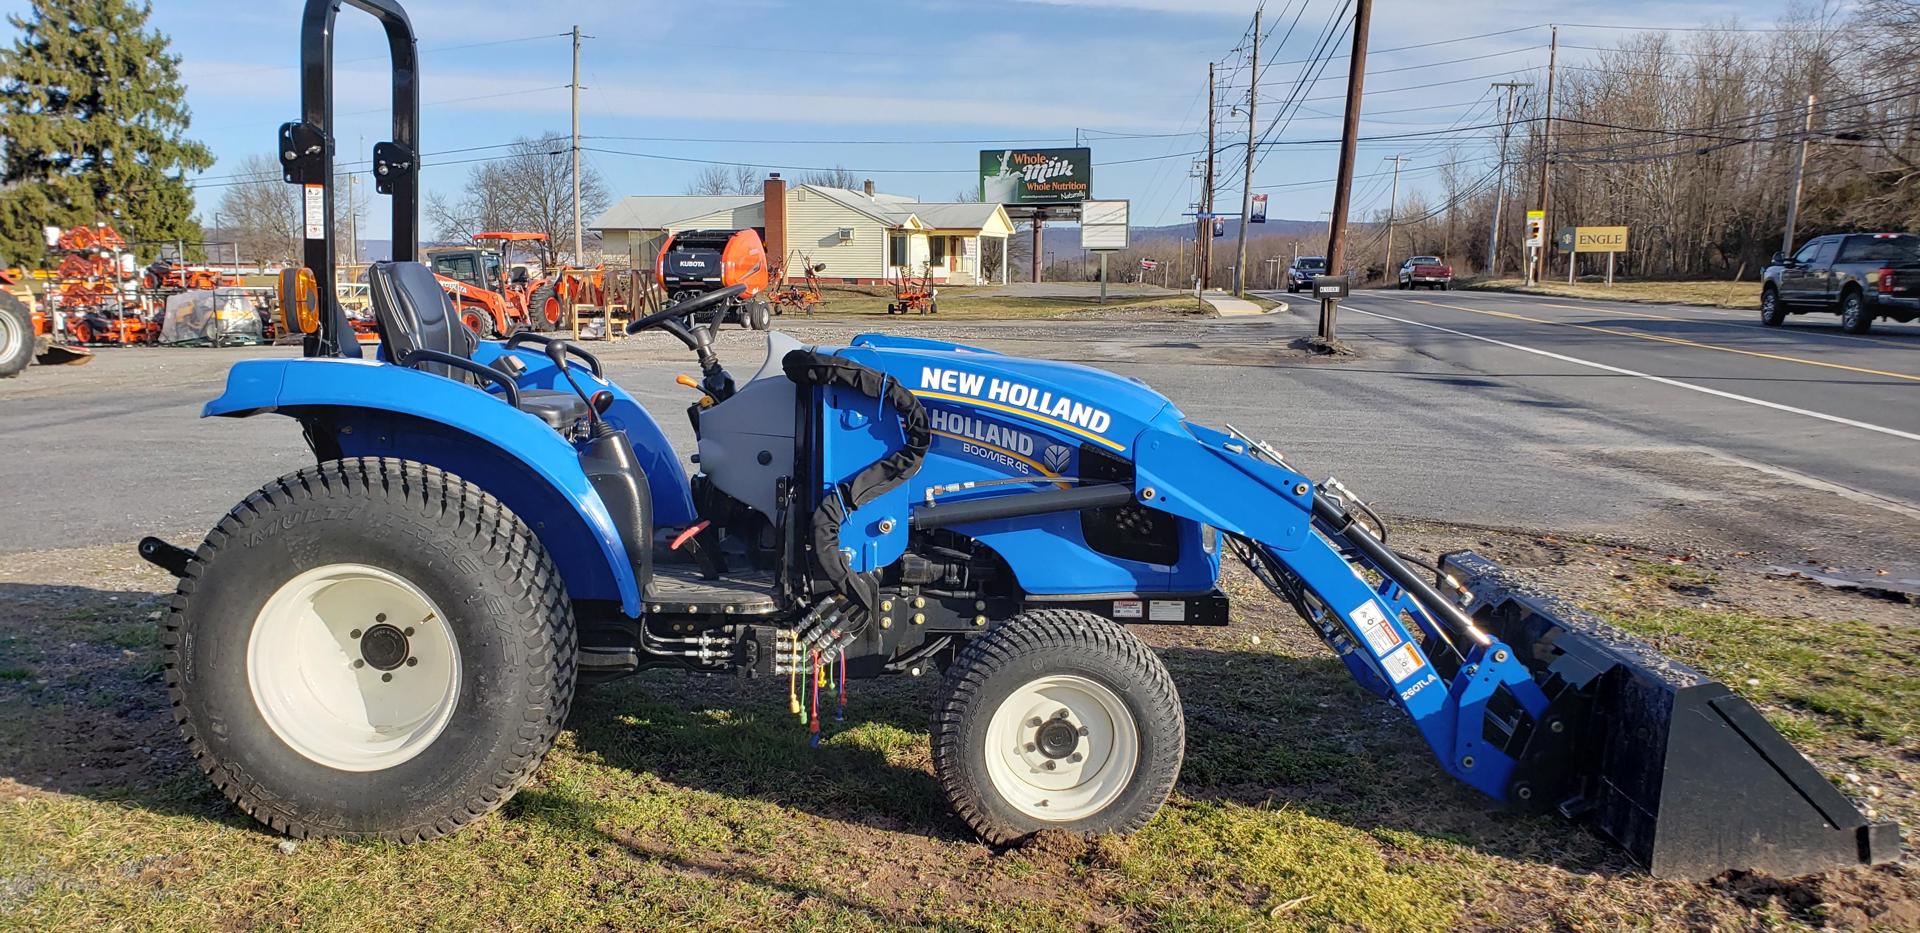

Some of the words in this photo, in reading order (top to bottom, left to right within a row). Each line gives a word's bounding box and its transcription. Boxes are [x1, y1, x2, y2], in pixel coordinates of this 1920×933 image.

[1013, 153, 1046, 164] Whole
[1027, 182, 1051, 191] Whole
[1052, 181, 1086, 191] Nutrition
[1579, 234, 1623, 245] ENGLE
[921, 366, 985, 396] NEW
[988, 378, 1111, 434] HOLLAND
[931, 409, 1034, 457] HOLLAND
[963, 443, 1014, 467] BOOMER
[1014, 460, 1029, 475] 45
[1400, 673, 1437, 700] 260TLA
